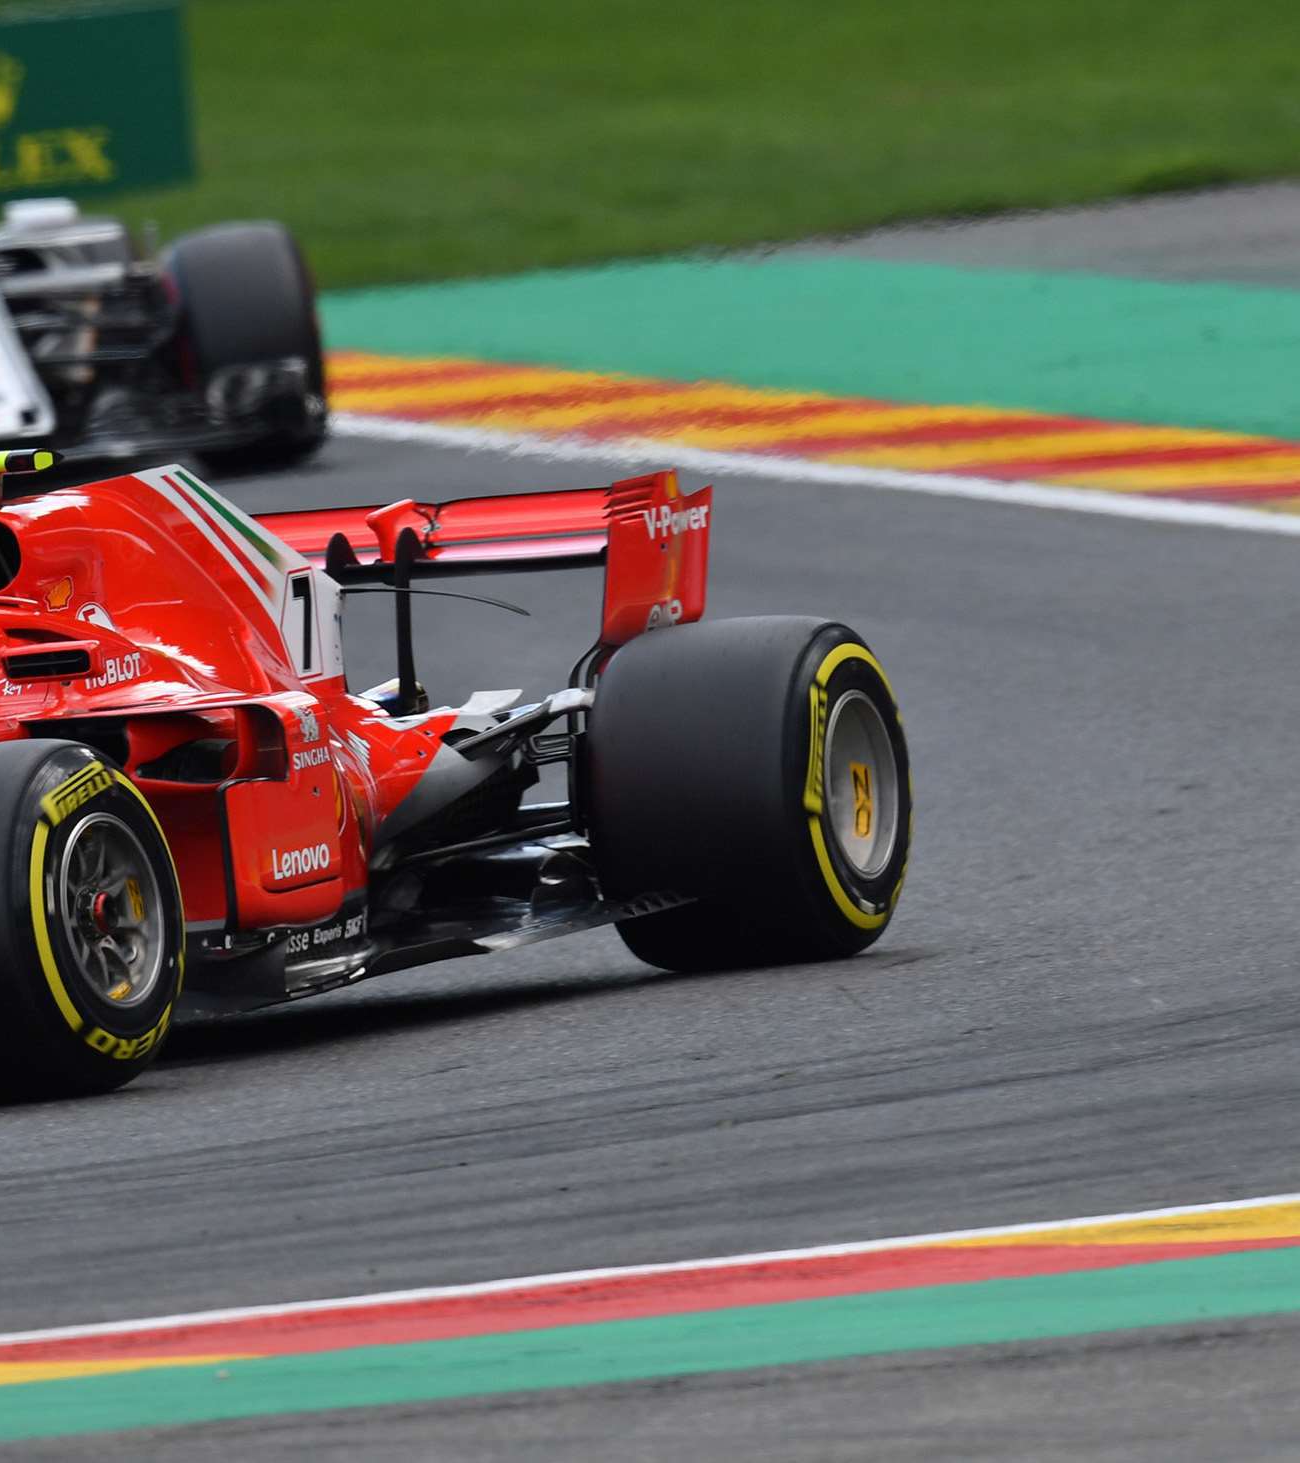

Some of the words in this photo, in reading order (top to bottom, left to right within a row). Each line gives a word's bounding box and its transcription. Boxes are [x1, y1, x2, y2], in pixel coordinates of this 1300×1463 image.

[644, 505, 709, 540] V-Power
[291, 575, 312, 671] 7
[293, 746, 330, 771] SINGHA
[40, 760, 115, 827] PIRELLI
[272, 843, 330, 881] Lenovo
